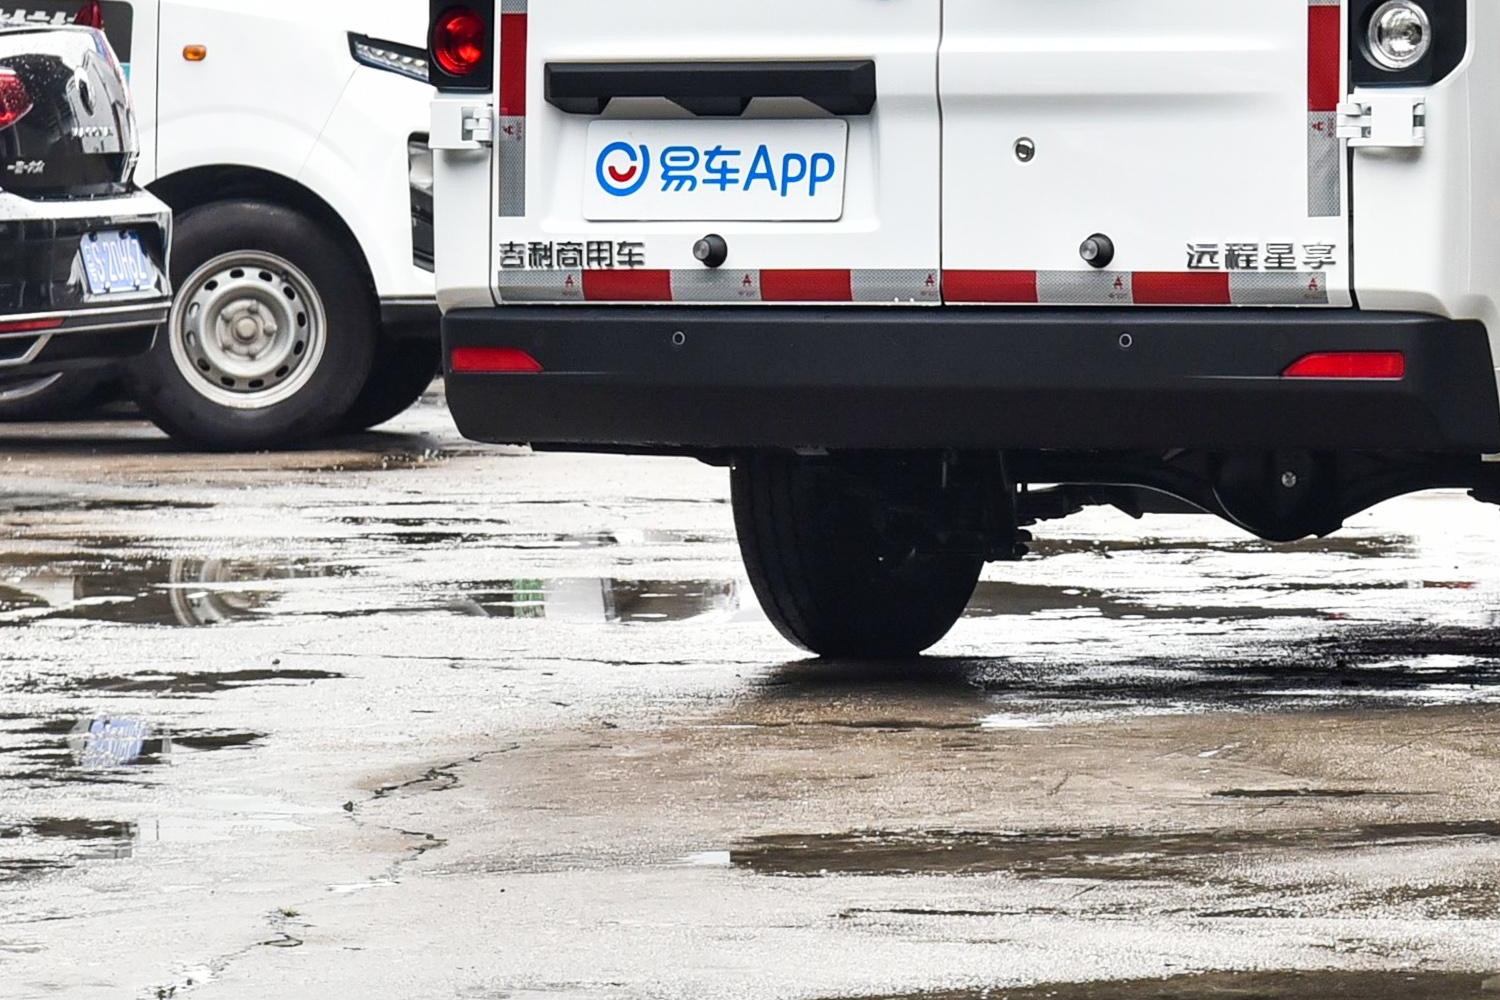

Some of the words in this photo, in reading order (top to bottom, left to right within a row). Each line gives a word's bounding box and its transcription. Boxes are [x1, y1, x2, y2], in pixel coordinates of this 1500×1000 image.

[660, 144, 835, 197] 易车App
[499, 241, 645, 268] 吉利商用车
[1186, 242, 1336, 269] 远程星享
